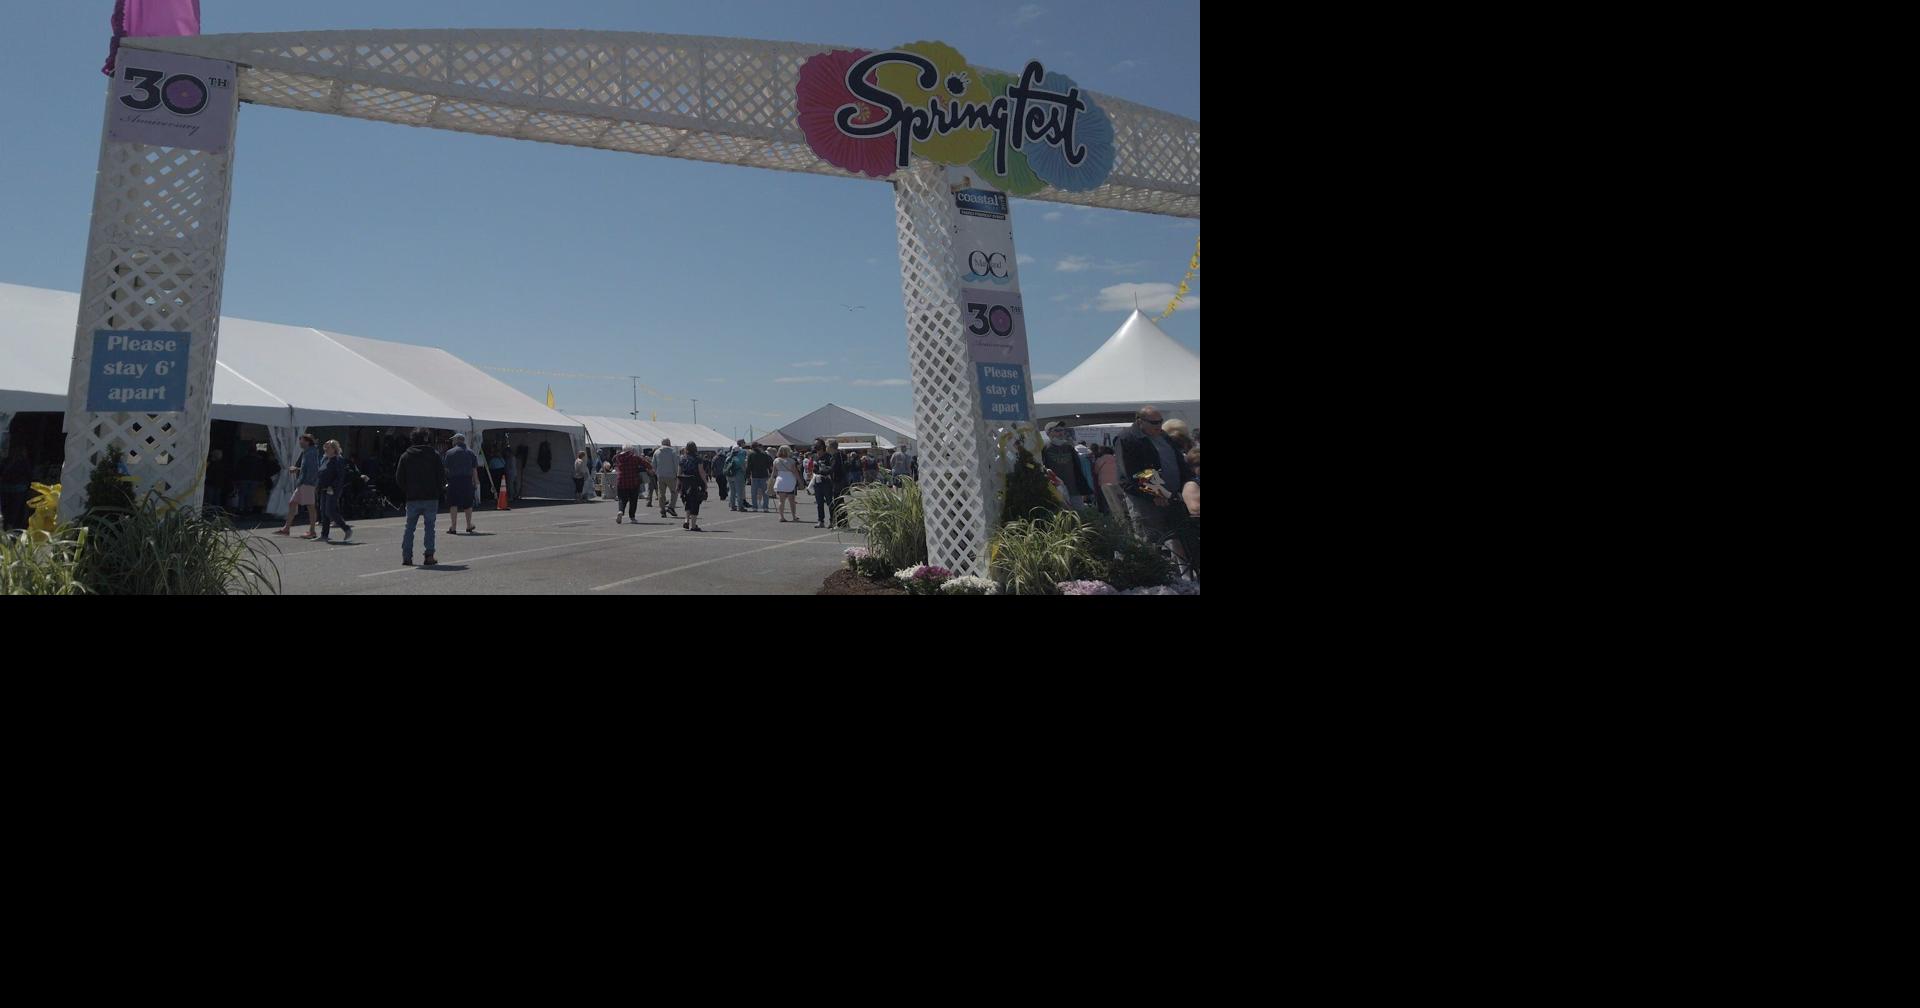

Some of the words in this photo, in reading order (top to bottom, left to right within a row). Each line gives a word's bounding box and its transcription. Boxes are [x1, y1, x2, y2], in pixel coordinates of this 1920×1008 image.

[119, 67, 228, 115] 30TH
[836, 51, 1086, 175] Springfest
[957, 192, 1000, 207] coastal
[968, 250, 1009, 278] OC
[107, 335, 177, 352] Please
[103, 361, 149, 379] stay
[154, 360, 176, 376] 6'
[983, 366, 1018, 379] Please
[107, 385, 167, 404] apart
[985, 384, 1008, 397] stay
[991, 401, 1020, 415] apart
